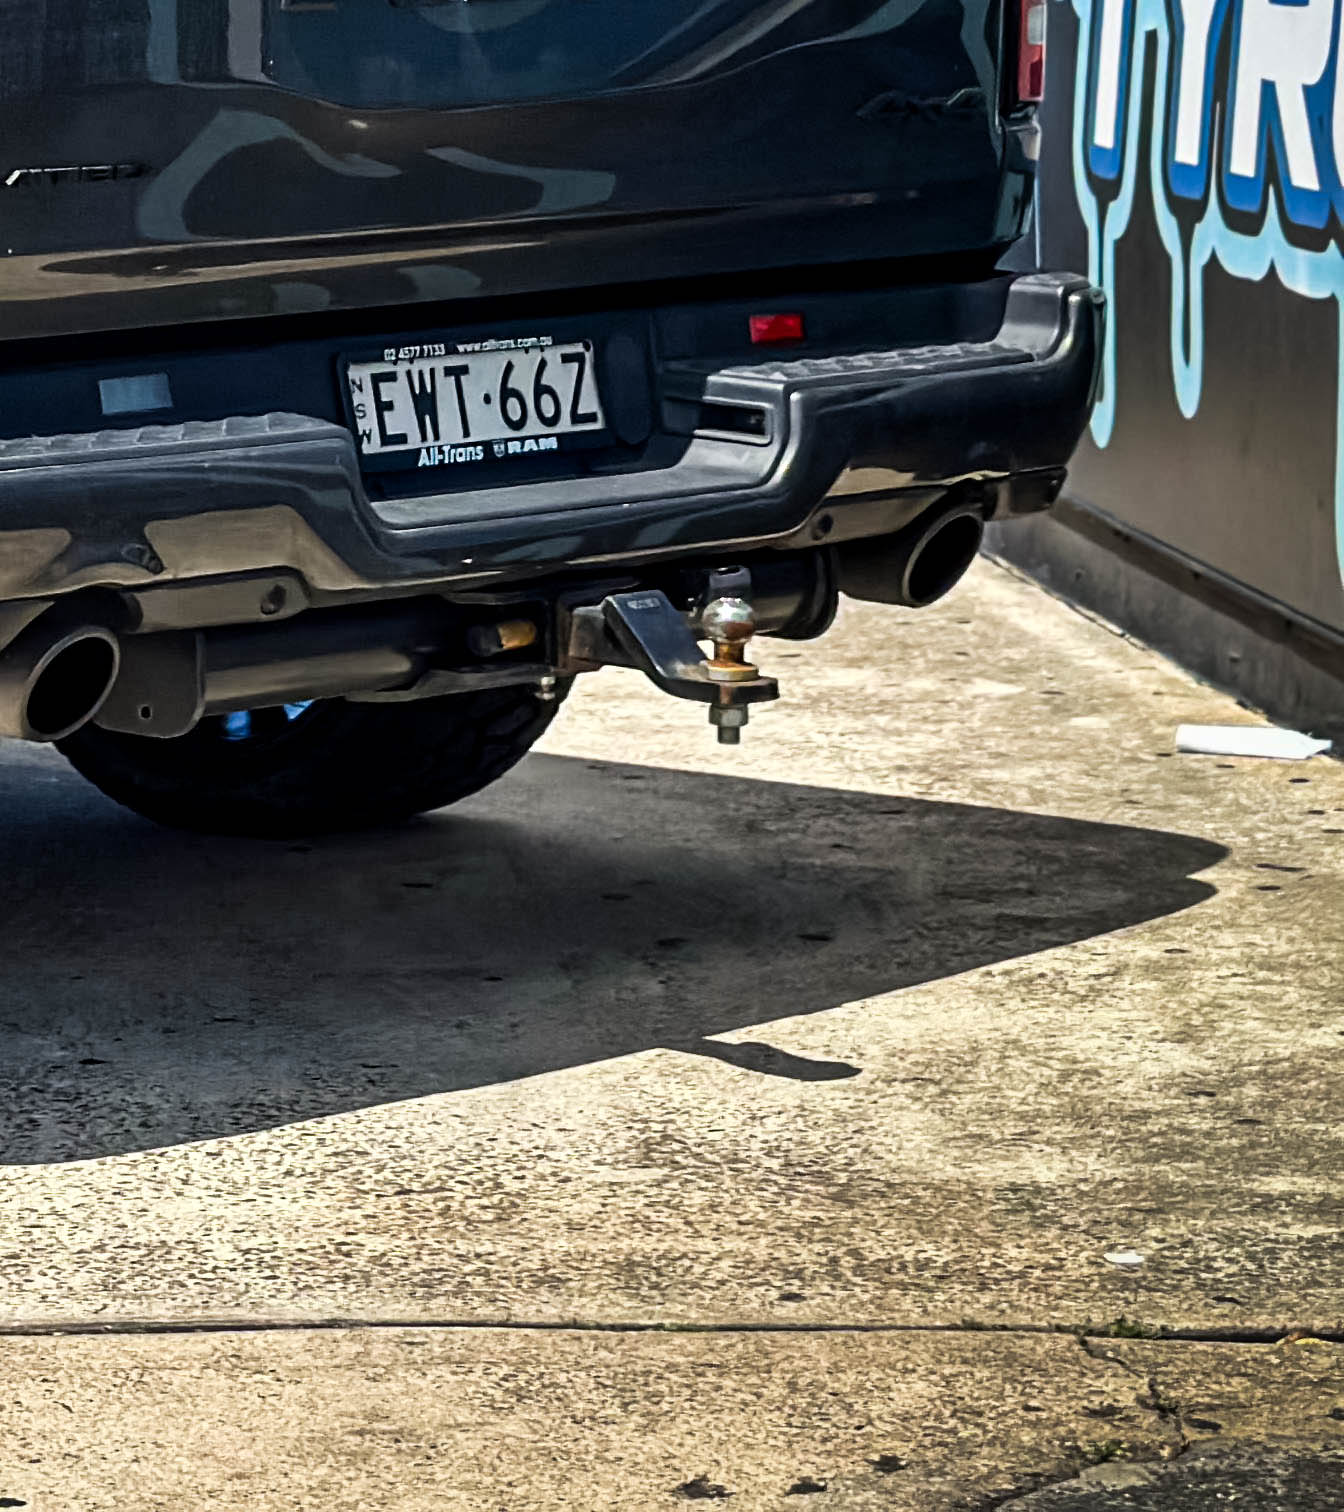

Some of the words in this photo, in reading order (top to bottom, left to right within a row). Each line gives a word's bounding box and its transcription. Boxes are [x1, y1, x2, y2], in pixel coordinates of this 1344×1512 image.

[384, 348, 396, 361] 02
[417, 445, 484, 467] All-Trans
[507, 436, 558, 454] RAM
